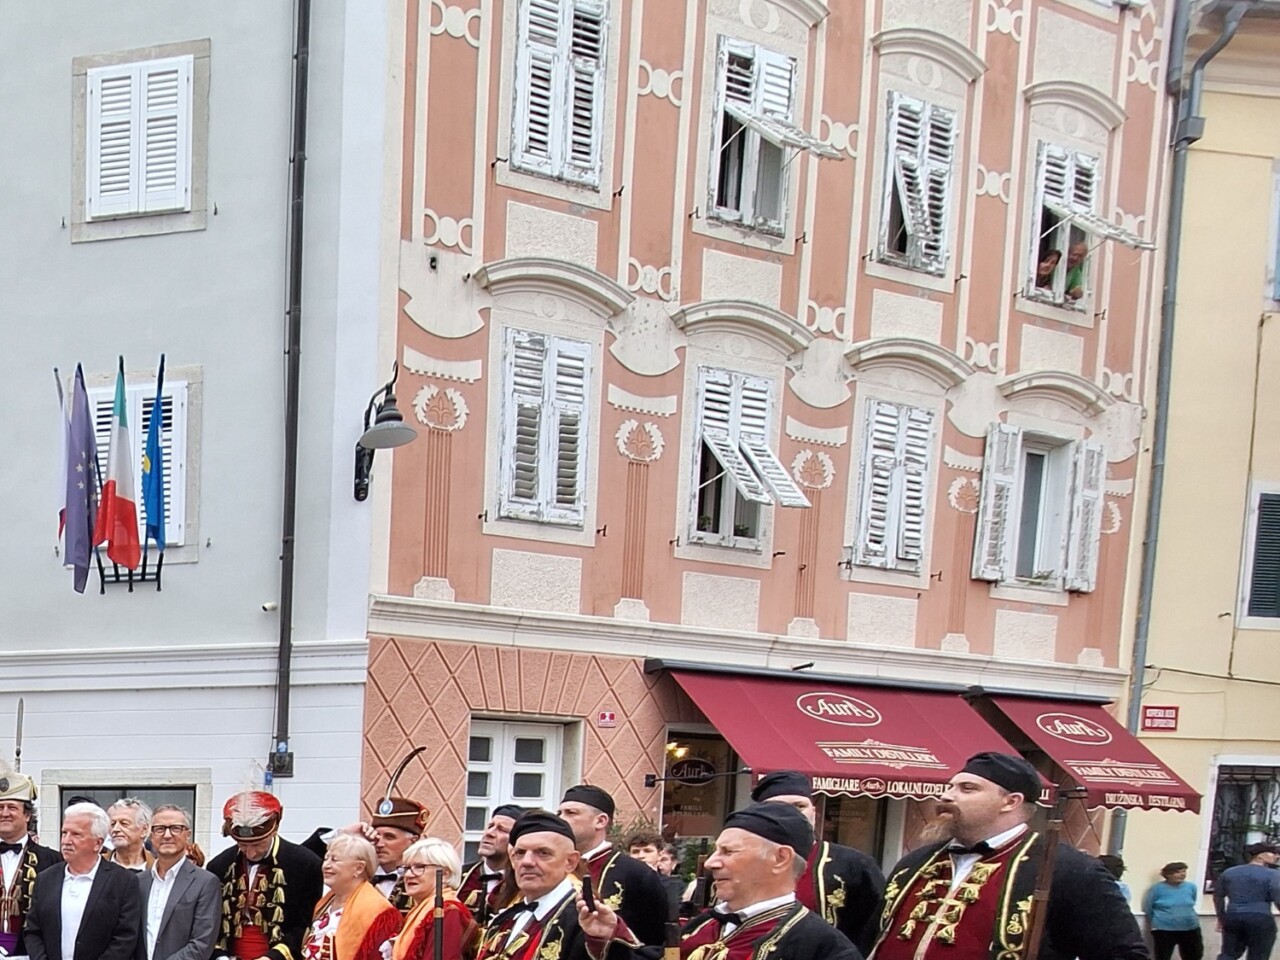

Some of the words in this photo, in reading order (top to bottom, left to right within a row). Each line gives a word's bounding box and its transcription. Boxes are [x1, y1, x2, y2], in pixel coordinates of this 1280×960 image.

[822, 747, 873, 759] FAMILY
[874, 749, 941, 763] DISTILLERY
[1071, 766, 1115, 777] FAMILY
[1113, 768, 1171, 780] DISTILLERY
[812, 776, 860, 792] FAMIGLIARE
[887, 780, 923, 794] LOKALNI
